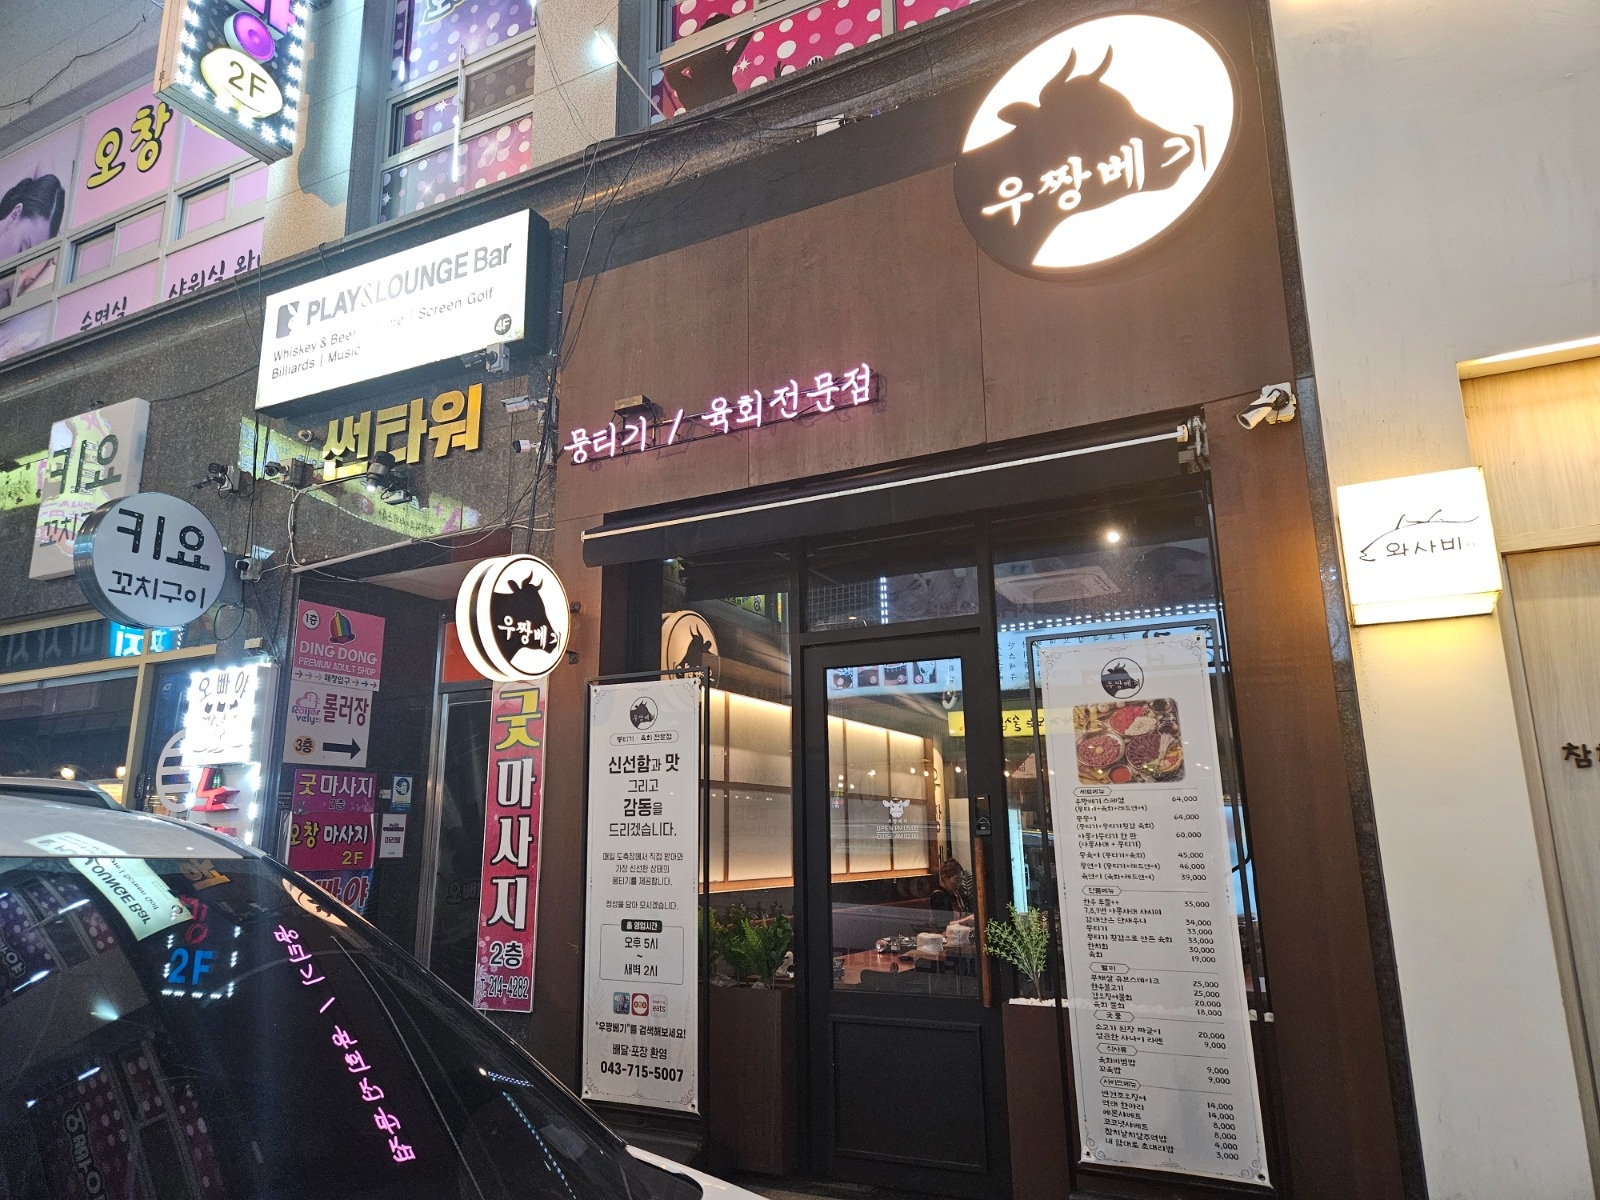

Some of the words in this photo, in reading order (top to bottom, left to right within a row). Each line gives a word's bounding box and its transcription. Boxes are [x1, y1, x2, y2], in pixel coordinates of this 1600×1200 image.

[228, 60, 268, 98] 2F
[86, 101, 173, 189] 오창
[981, 124, 1207, 226] 우짱베기
[474, 242, 512, 274] Bar
[273, 342, 316, 363] Whiskey
[418, 300, 462, 320] Screen
[467, 286, 494, 306] Golf
[496, 317, 511, 332] 4F
[271, 358, 316, 380] Billiards
[327, 346, 361, 364] Music
[322, 382, 483, 482] 썬타워
[564, 415, 647, 464] 뭉티기
[50, 433, 122, 494] 키요
[40, 511, 90, 547] 꼬치
[116, 507, 211, 572] 키요
[1385, 536, 1462, 557] 와사비
[107, 570, 206, 610] 꼬치구이
[305, 613, 319, 626] 1층
[497, 615, 561, 652] 우짱베기
[300, 641, 336, 658] DING
[337, 649, 378, 665] DONG
[298, 658, 332, 669] PREMIUM
[332, 662, 356, 673] ADULT
[357, 666, 376, 676] SHOP
[322, 693, 369, 726] 롤러장
[295, 738, 314, 754] 3층
[608, 754, 662, 774] 신선함과
[664, 752, 680, 773] 맛
[1561, 742, 1600, 769] 참
[627, 778, 660, 793] 그리고
[623, 797, 664, 818] 감동을
[323, 824, 369, 846] 마사지
[608, 821, 678, 838] 드리겠습니다.
[341, 850, 364, 866] 2F
[602, 852, 615, 861] 매일
[649, 852, 663, 861] 직접
[615, 864, 628, 873] 가장
[629, 864, 649, 874] 신선한
[650, 865, 670, 874] 상태의
[606, 900, 624, 909] 정성을
[625, 901, 638, 909] 담아
[1083, 898, 1096, 906] 한우
[1140, 908, 1162, 916] 사시미
[633, 921, 659, 931] 영업시간
[1185, 919, 1212, 927] 34,000
[624, 936, 641, 949] 오후
[643, 937, 659, 950] 5시
[1188, 946, 1215, 954] 30,000
[490, 941, 523, 969] 2층
[1191, 955, 1216, 963] 19,000
[168, 946, 214, 985] 2F
[624, 963, 641, 976] 새벽
[643, 965, 658, 977] 2시
[488, 975, 530, 998] 214-4282
[1091, 982, 1124, 991] 한우불고기
[1194, 990, 1220, 998] 25,000
[1192, 980, 1219, 988] 25,000
[652, 1004, 666, 1013] eats
[1194, 1000, 1222, 1008] 20,000
[1197, 1009, 1222, 1017] 18,000
[639, 1024, 687, 1039] 검색해보세요!
[1095, 1023, 1116, 1031] 소고기
[1119, 1025, 1135, 1033] 된장
[1198, 1031, 1225, 1040] 20,000
[1096, 1032, 1119, 1041] 얼큰한
[1204, 1041, 1226, 1050] 9,000
[650, 1046, 668, 1060] 환영
[600, 1060, 684, 1083] 043-715-5007
[1098, 1056, 1136, 1066] 육회비빔밥
[1206, 1066, 1229, 1075] 9,000
[1208, 1076, 1230, 1085] 9,000
[1101, 1090, 1147, 1101] 반건조오징어
[1207, 1102, 1233, 1111] 14,000
[1208, 1111, 1235, 1121] 14,000
[1104, 1118, 1148, 1131] 코코넛샤베트
[1214, 1132, 1237, 1141] 8,000
[1213, 1121, 1236, 1131] 8,000
[1105, 1137, 1113, 1145] 내
[1216, 1151, 1239, 1160] 3,000
[1214, 1142, 1238, 1150] 4,000
